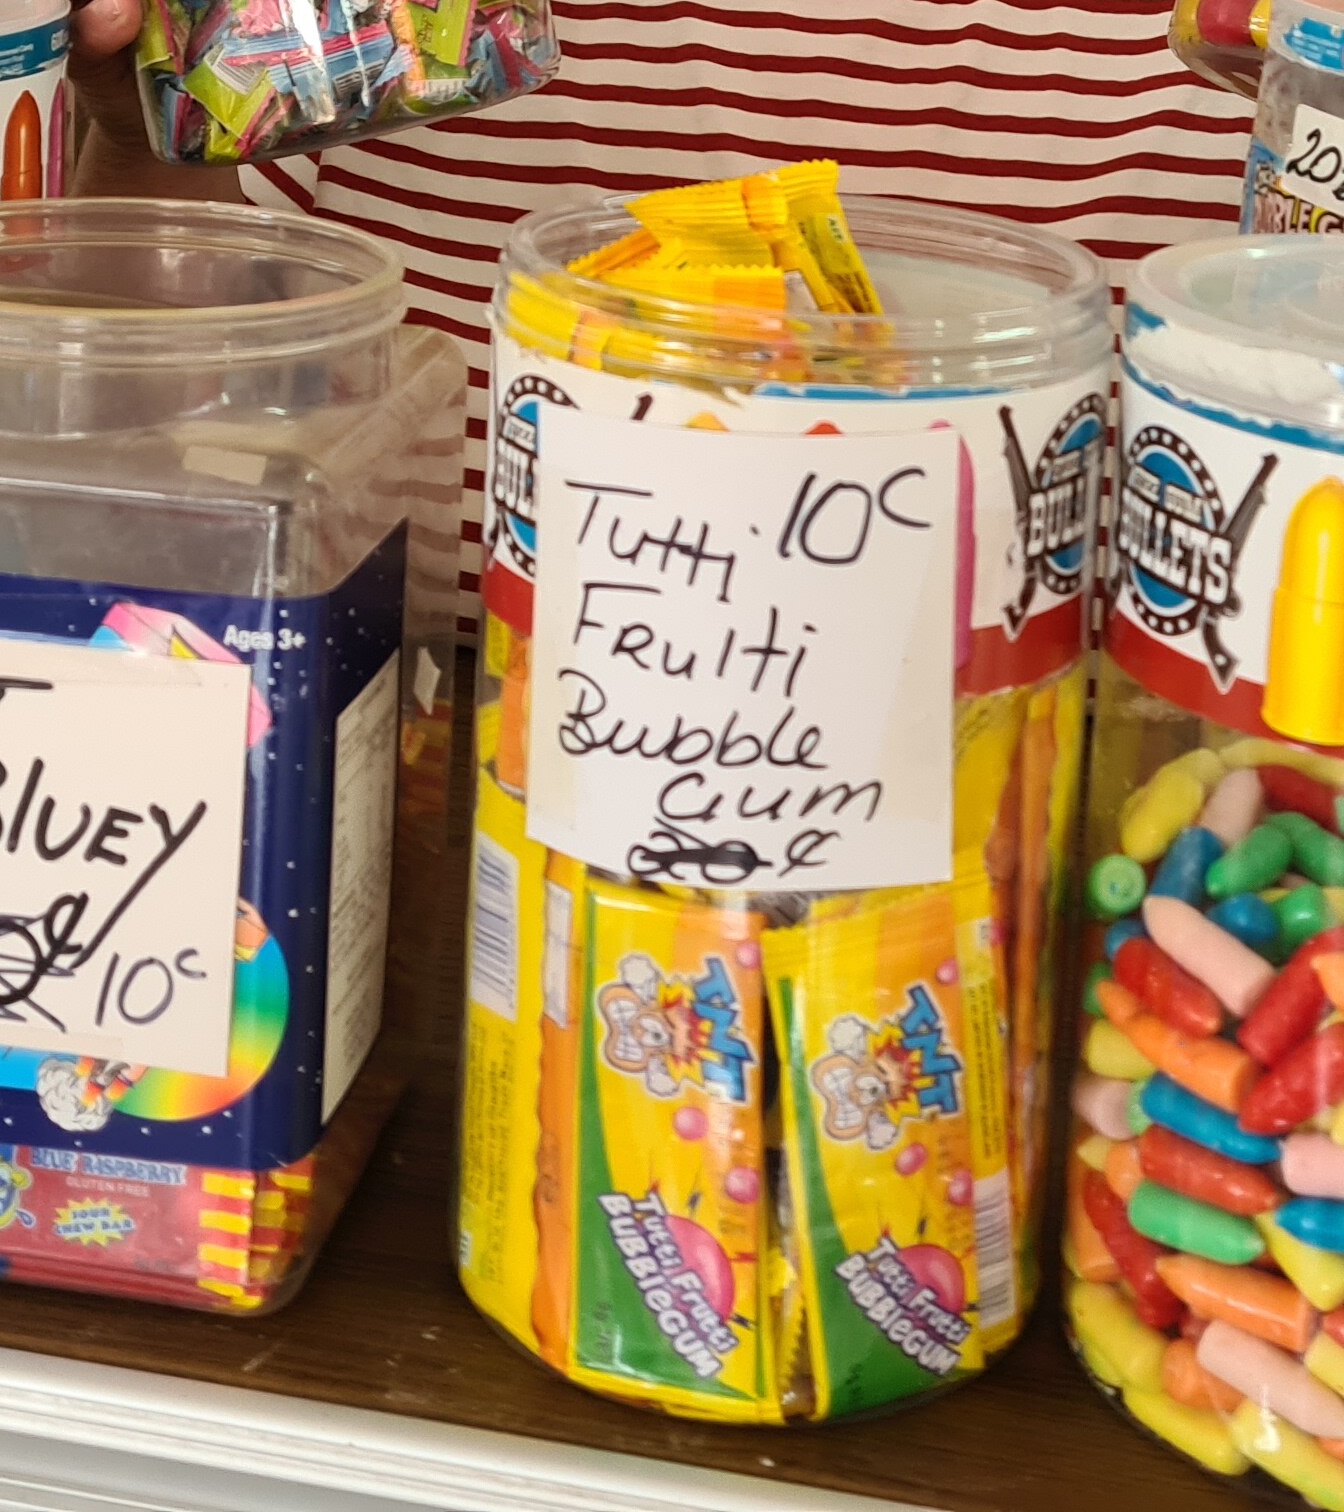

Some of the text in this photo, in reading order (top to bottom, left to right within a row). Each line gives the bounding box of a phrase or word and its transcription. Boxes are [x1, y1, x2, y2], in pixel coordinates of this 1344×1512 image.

[565, 479, 739, 603] Tutti
[222, 625, 308, 655] Ages 3+
[558, 668, 829, 772] Bubble
[656, 772, 883, 825] Gum
[693, 958, 753, 1101] TNT
[902, 984, 961, 1114] TNT
[29, 1146, 188, 1185] BLUE RASPBERRY
